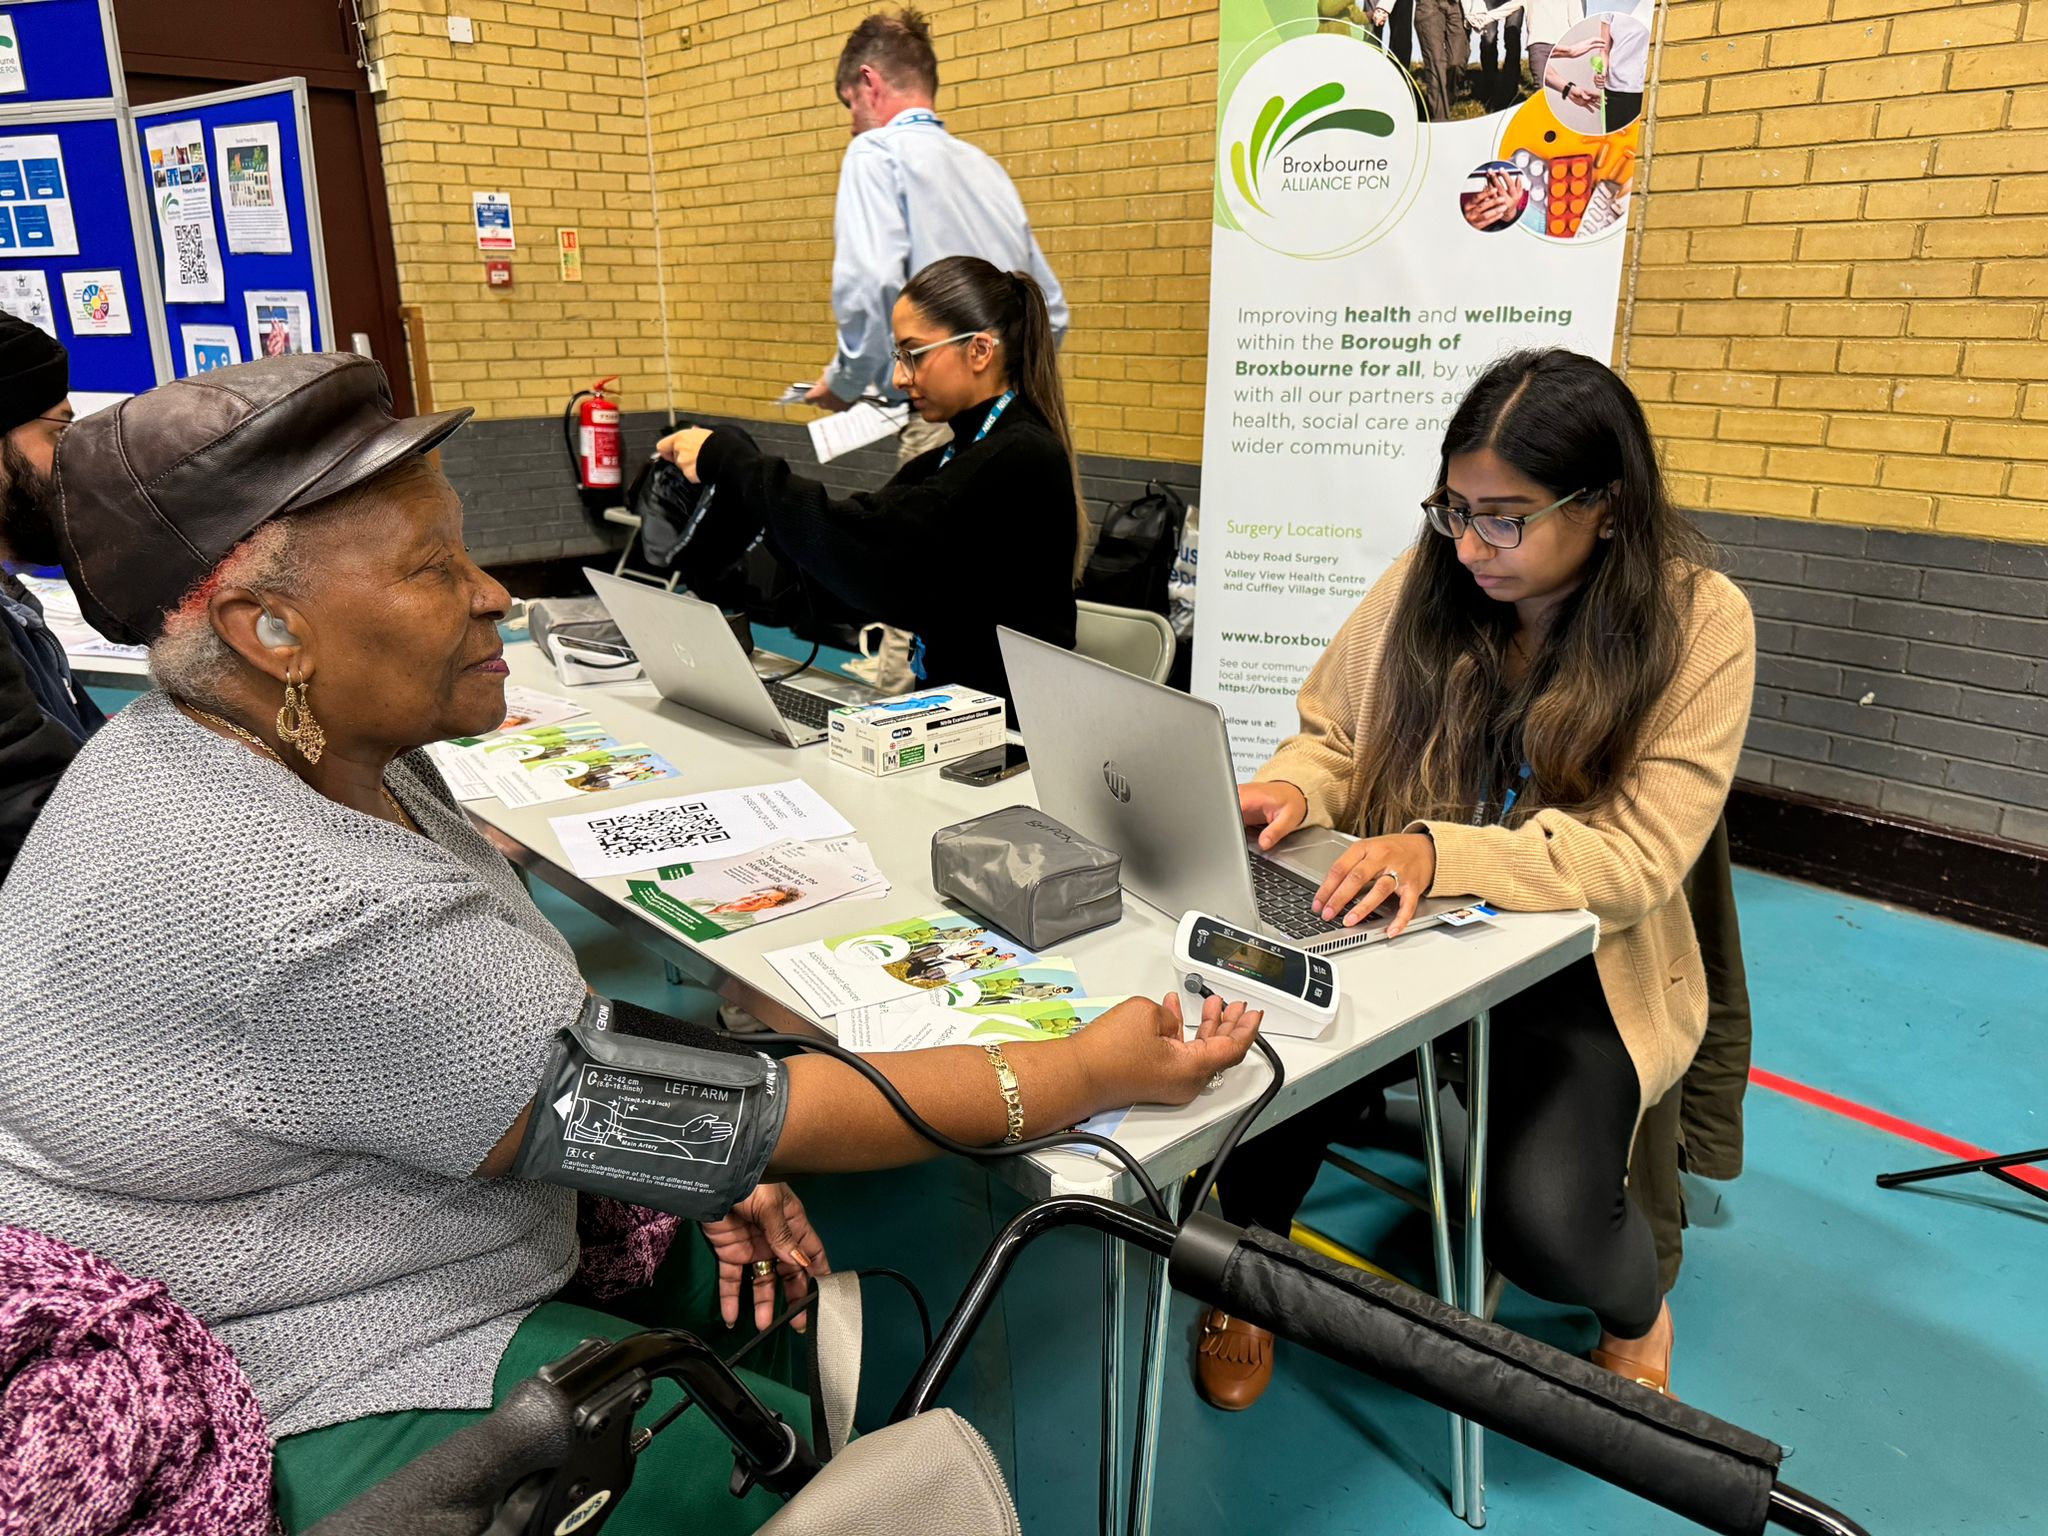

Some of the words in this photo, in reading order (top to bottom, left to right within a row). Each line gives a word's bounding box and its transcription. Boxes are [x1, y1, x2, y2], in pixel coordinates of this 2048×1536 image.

[1282, 155, 1388, 174] Broxbourne
[1281, 175, 1352, 191] ALLIANCE
[1358, 175, 1390, 190] PCN
[1238, 307, 1338, 326] Improving
[1344, 306, 1411, 323] health
[1418, 307, 1456, 323] and
[1464, 306, 1572, 326] wellbeing
[1237, 334, 1295, 351] within
[1302, 334, 1334, 350] the
[1340, 334, 1431, 352] Borough
[1438, 334, 1461, 350] of
[1235, 361, 1353, 377] Broxbourne
[1359, 360, 1389, 377] for
[1396, 360, 1426, 380] all,
[1433, 361, 1458, 381] by
[1234, 387, 1273, 404] with
[1280, 387, 1302, 404] all
[1308, 390, 1340, 404] our
[1349, 389, 1434, 407] partners
[1232, 413, 1295, 432] health,
[1302, 413, 1358, 430] social
[1365, 416, 1409, 431] care
[1232, 439, 1284, 456] wider
[1290, 441, 1406, 459] community.
[1226, 519, 1283, 539] Surgery
[1288, 522, 1363, 539] Locations
[1225, 550, 1260, 563] Abbey
[1263, 552, 1292, 562] Road
[1295, 553, 1339, 565] Surgery
[1224, 569, 1256, 581] Valley
[1259, 571, 1285, 581] View
[1289, 571, 1325, 583] Health
[1328, 573, 1366, 584] Centre
[1223, 582, 1243, 591] and
[1246, 582, 1284, 595] Cuffley
[1288, 585, 1326, 597] Village
[1328, 586, 1368, 598] Surger
[1219, 658, 1239, 668] See
[1241, 661, 1259, 670] our
[1218, 670, 1243, 681] local
[1246, 672, 1288, 684] services
[1218, 682, 1299, 697] https://broxbo
[1224, 717, 1248, 726] ollow
[628, 1078, 639, 1086] cm
[665, 1082, 698, 1096] LEFT
[700, 1088, 729, 1102] ARM
[621, 1139, 636, 1147] Main
[638, 1143, 658, 1151] Artery
[576, 1167, 605, 1176] supplied
[626, 1175, 645, 1183] result
[654, 1180, 698, 1192] measurement
[666, 1177, 693, 1186] different
